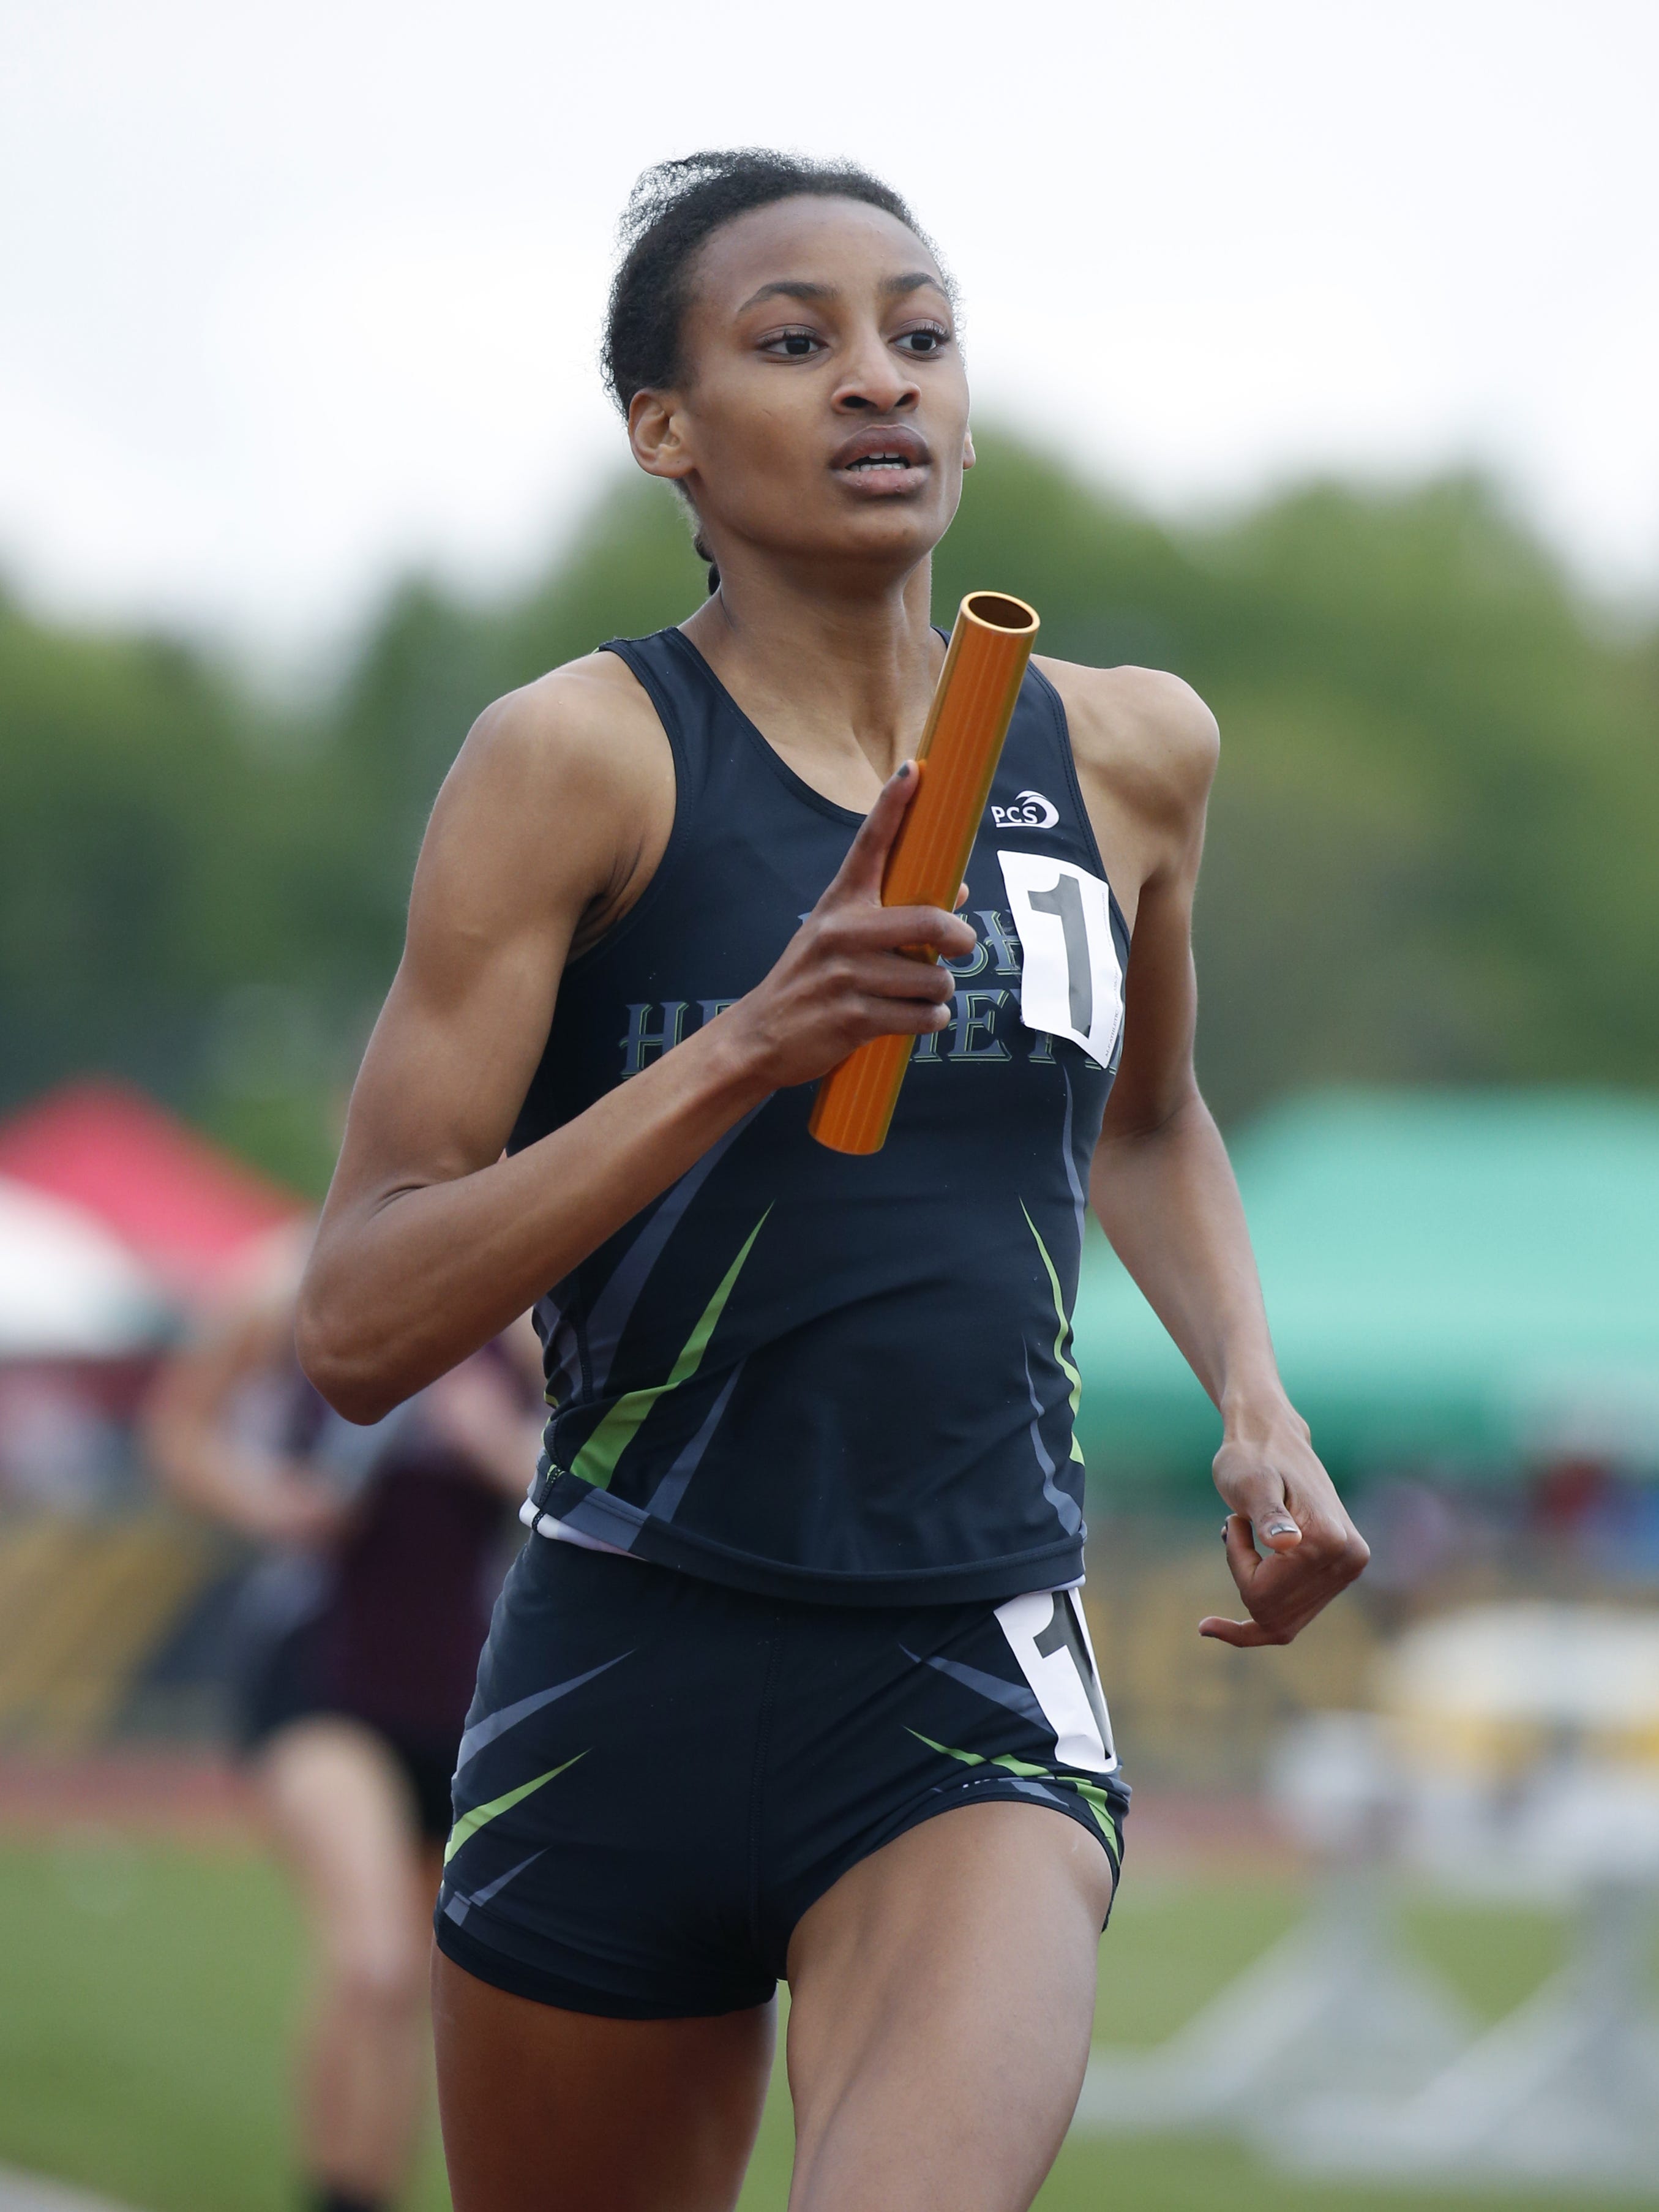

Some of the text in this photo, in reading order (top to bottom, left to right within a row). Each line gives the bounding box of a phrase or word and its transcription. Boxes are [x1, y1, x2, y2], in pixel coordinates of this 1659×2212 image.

[991, 806, 1038, 824] PCS
[1028, 874, 1093, 1040] 1
[1033, 1590, 1112, 1760] 1
